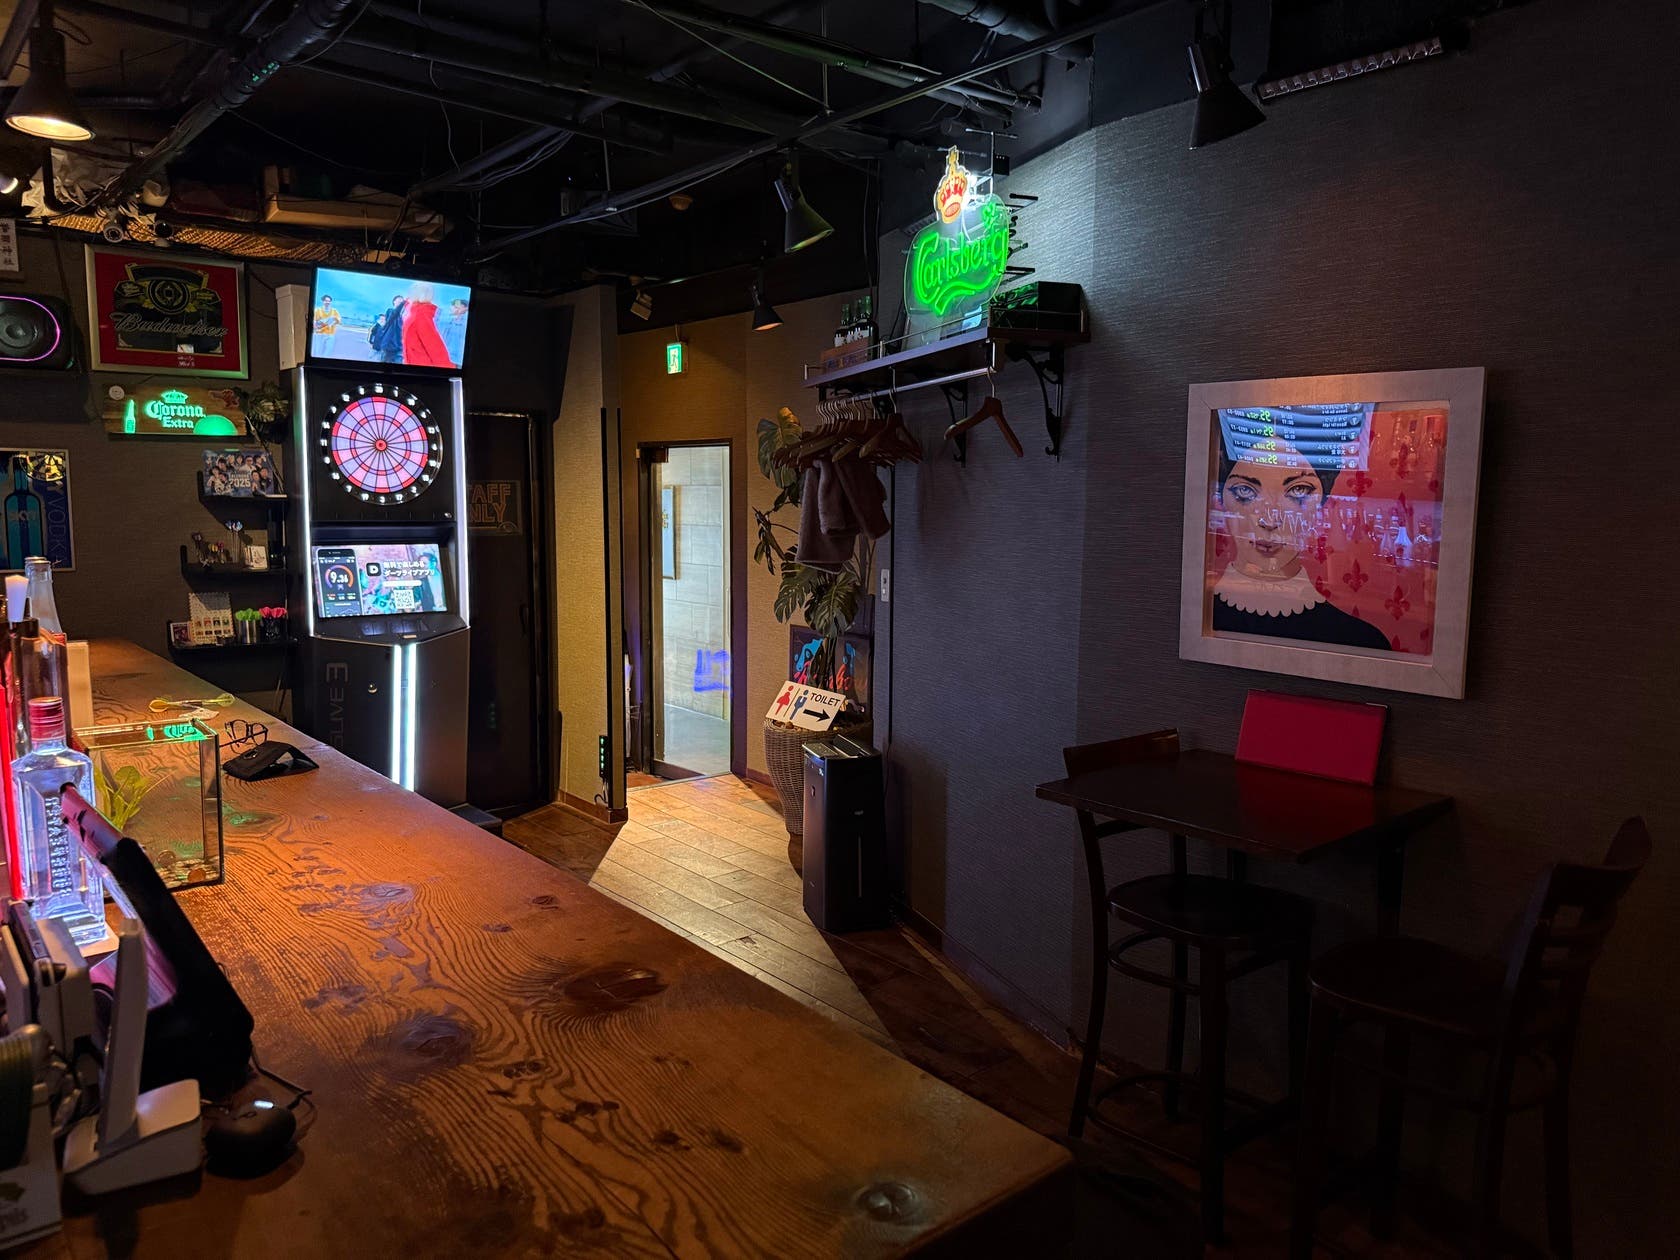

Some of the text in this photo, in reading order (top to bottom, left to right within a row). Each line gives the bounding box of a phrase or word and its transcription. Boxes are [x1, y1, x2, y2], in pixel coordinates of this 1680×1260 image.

[914, 228, 1009, 305] Carlsberg
[109, 312, 228, 338] Budweiser
[145, 400, 207, 421] Corona
[163, 415, 194, 429] Extra
[229, 478, 251, 488] 2025
[810, 692, 841, 708] TOILET
